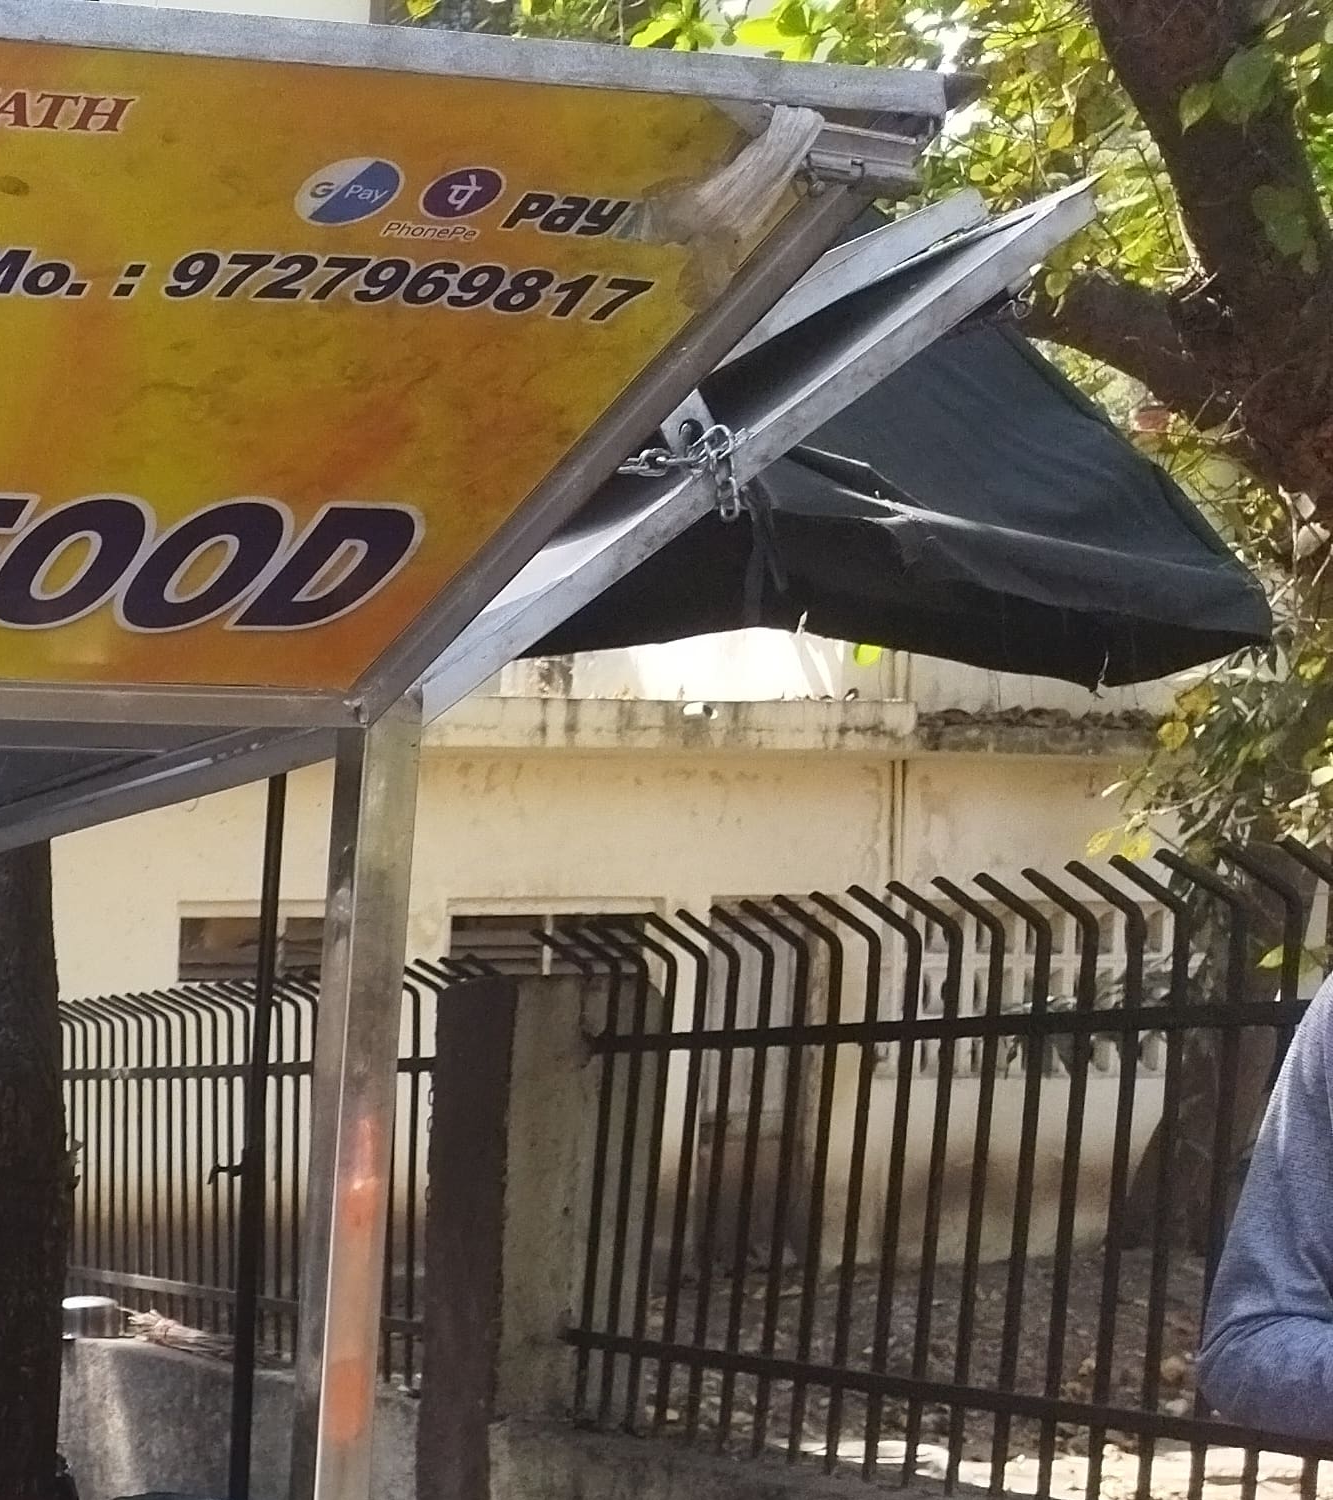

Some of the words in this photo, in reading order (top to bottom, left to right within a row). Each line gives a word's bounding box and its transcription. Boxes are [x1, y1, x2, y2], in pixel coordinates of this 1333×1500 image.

[344, 182, 390, 202] Pay
[382, 221, 478, 241] PhonePe
[164, 251, 655, 323] 9727969817
